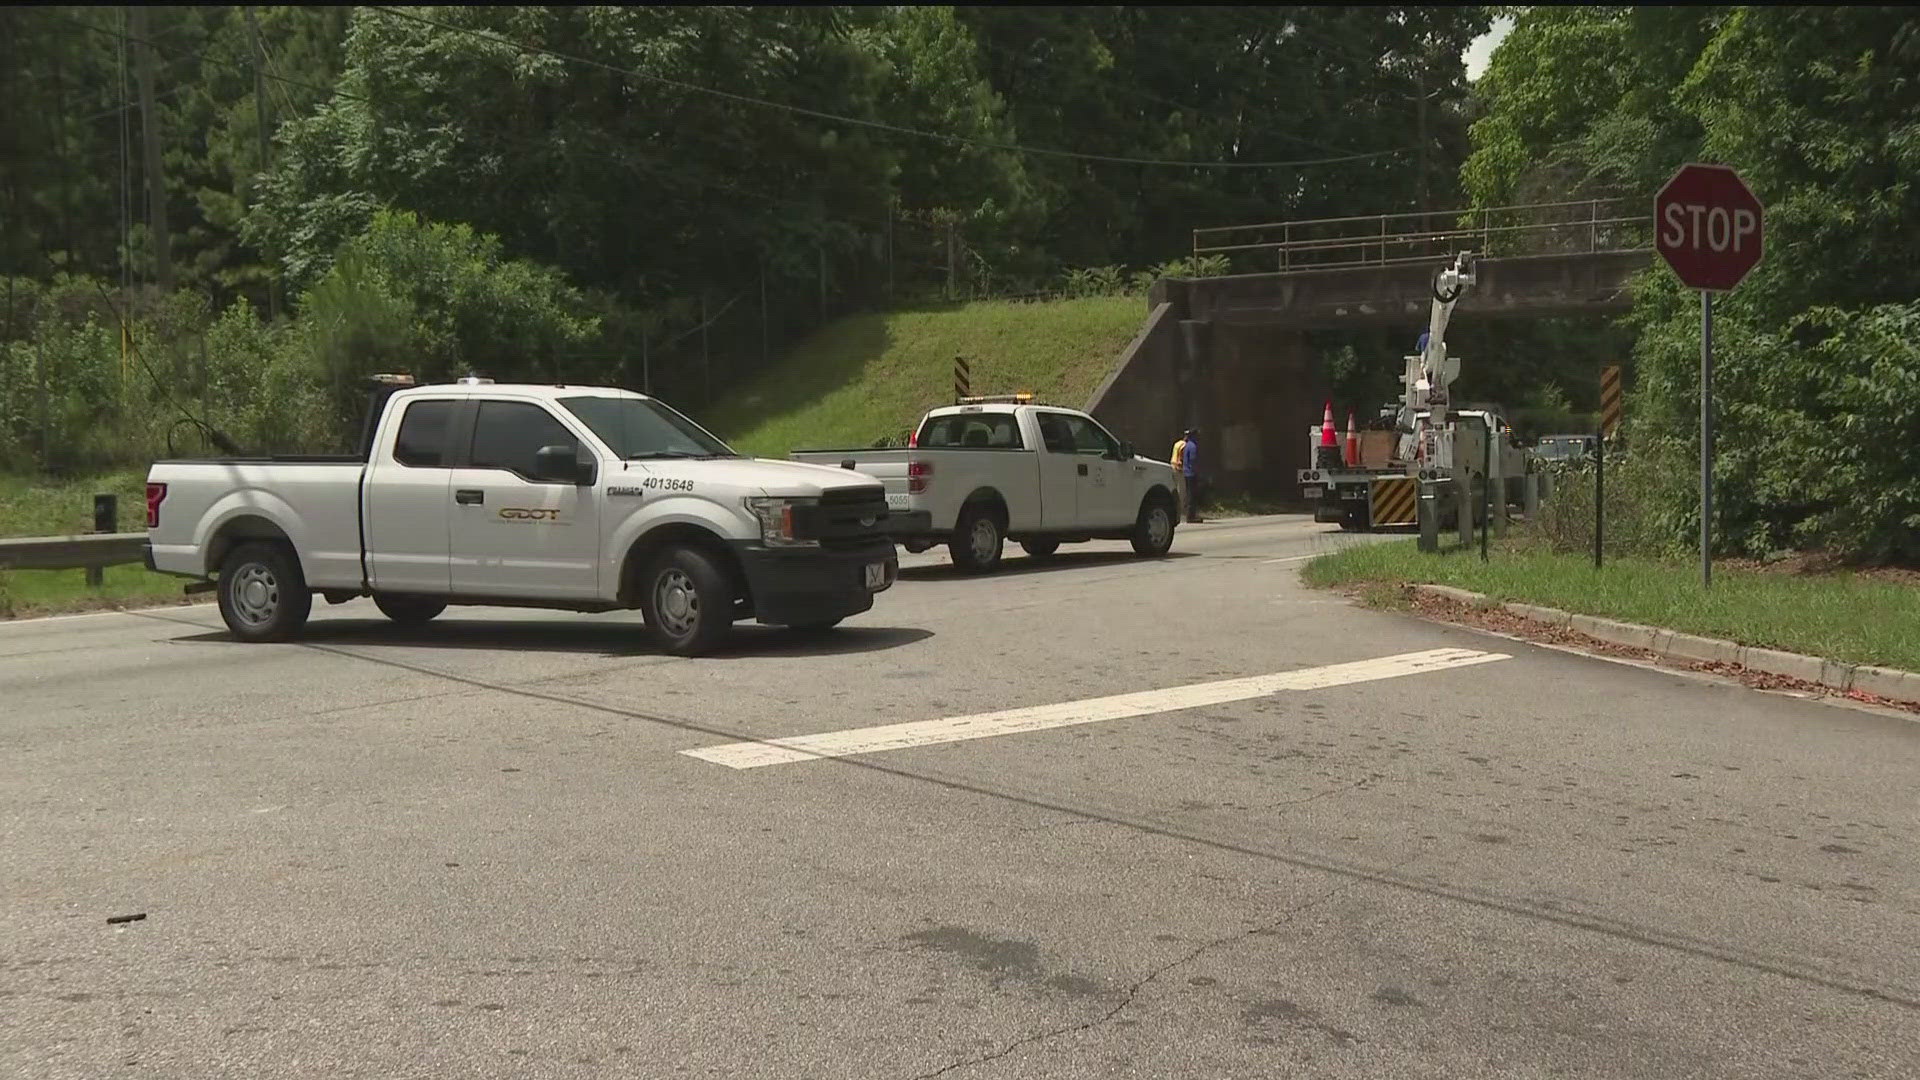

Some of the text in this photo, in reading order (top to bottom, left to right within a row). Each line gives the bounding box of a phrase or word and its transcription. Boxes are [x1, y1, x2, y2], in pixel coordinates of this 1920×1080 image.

[1662, 202, 1757, 253] STOP
[642, 477, 695, 492] 4013648
[498, 507, 561, 520] GDOT
